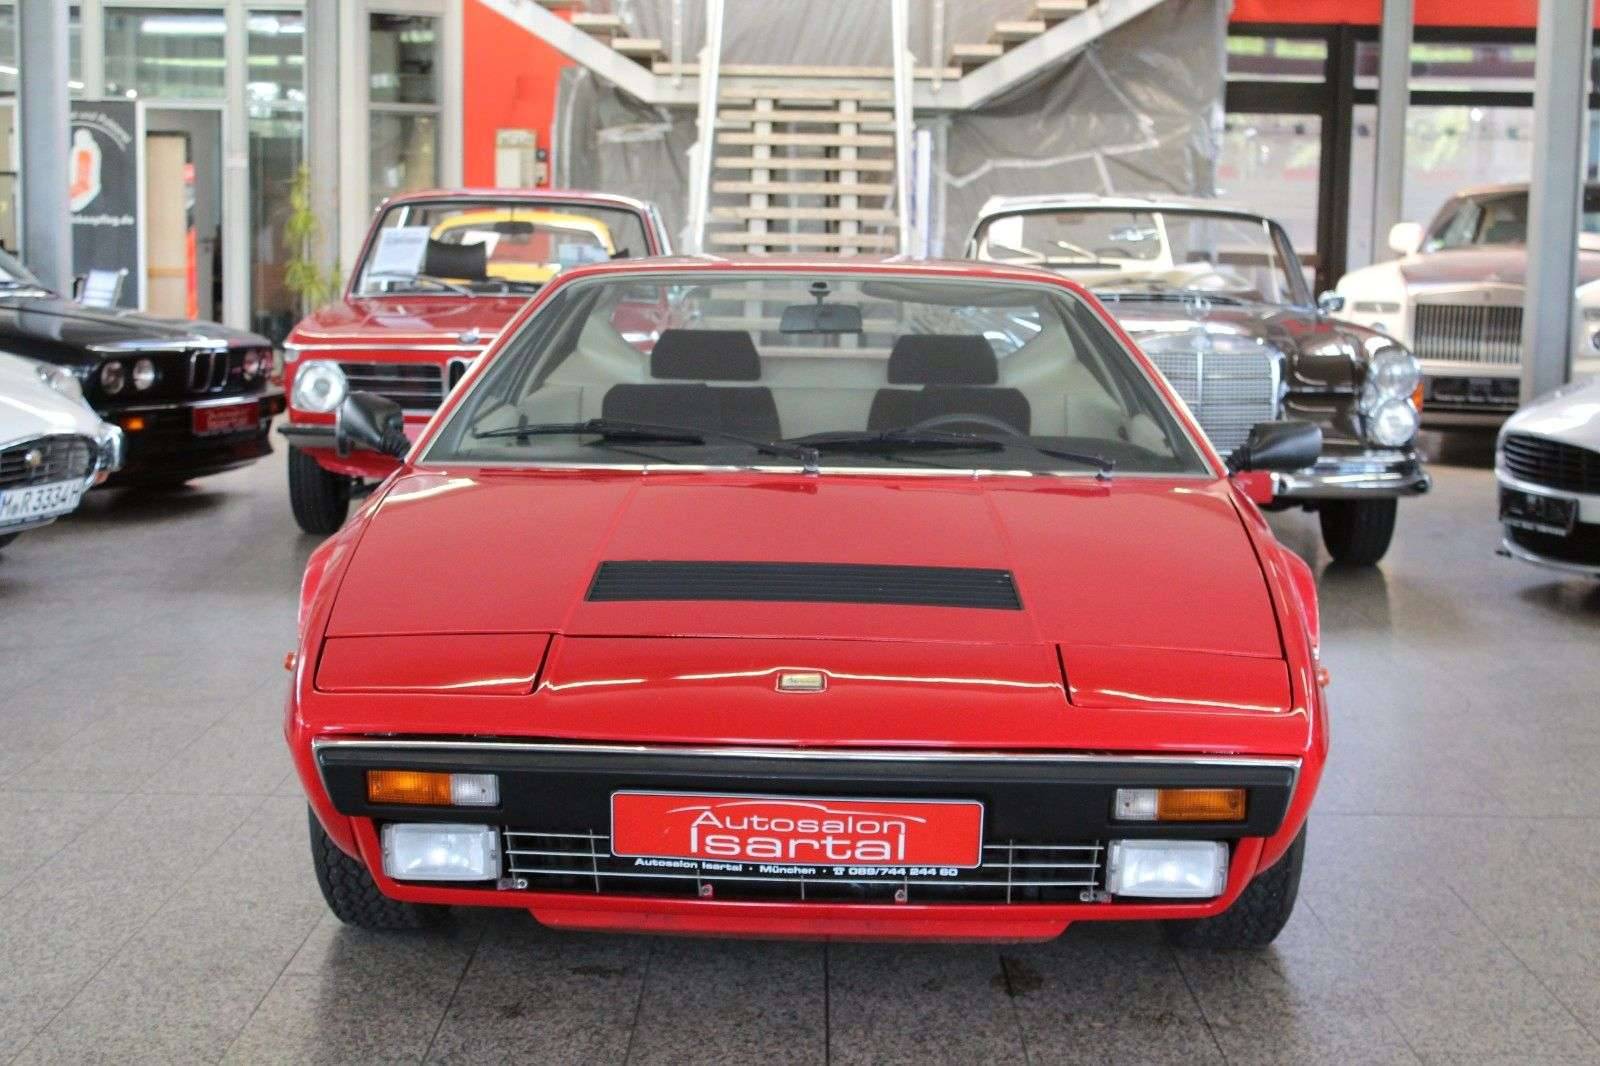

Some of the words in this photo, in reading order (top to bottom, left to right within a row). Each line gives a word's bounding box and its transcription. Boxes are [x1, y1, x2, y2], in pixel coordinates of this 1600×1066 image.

[691, 810, 906, 834] Autosalon
[690, 826, 905, 861] Isartal
[634, 857, 698, 870] Autosalon
[702, 860, 743, 872] Isartal
[759, 864, 816, 875] München
[909, 868, 937, 877] 244
